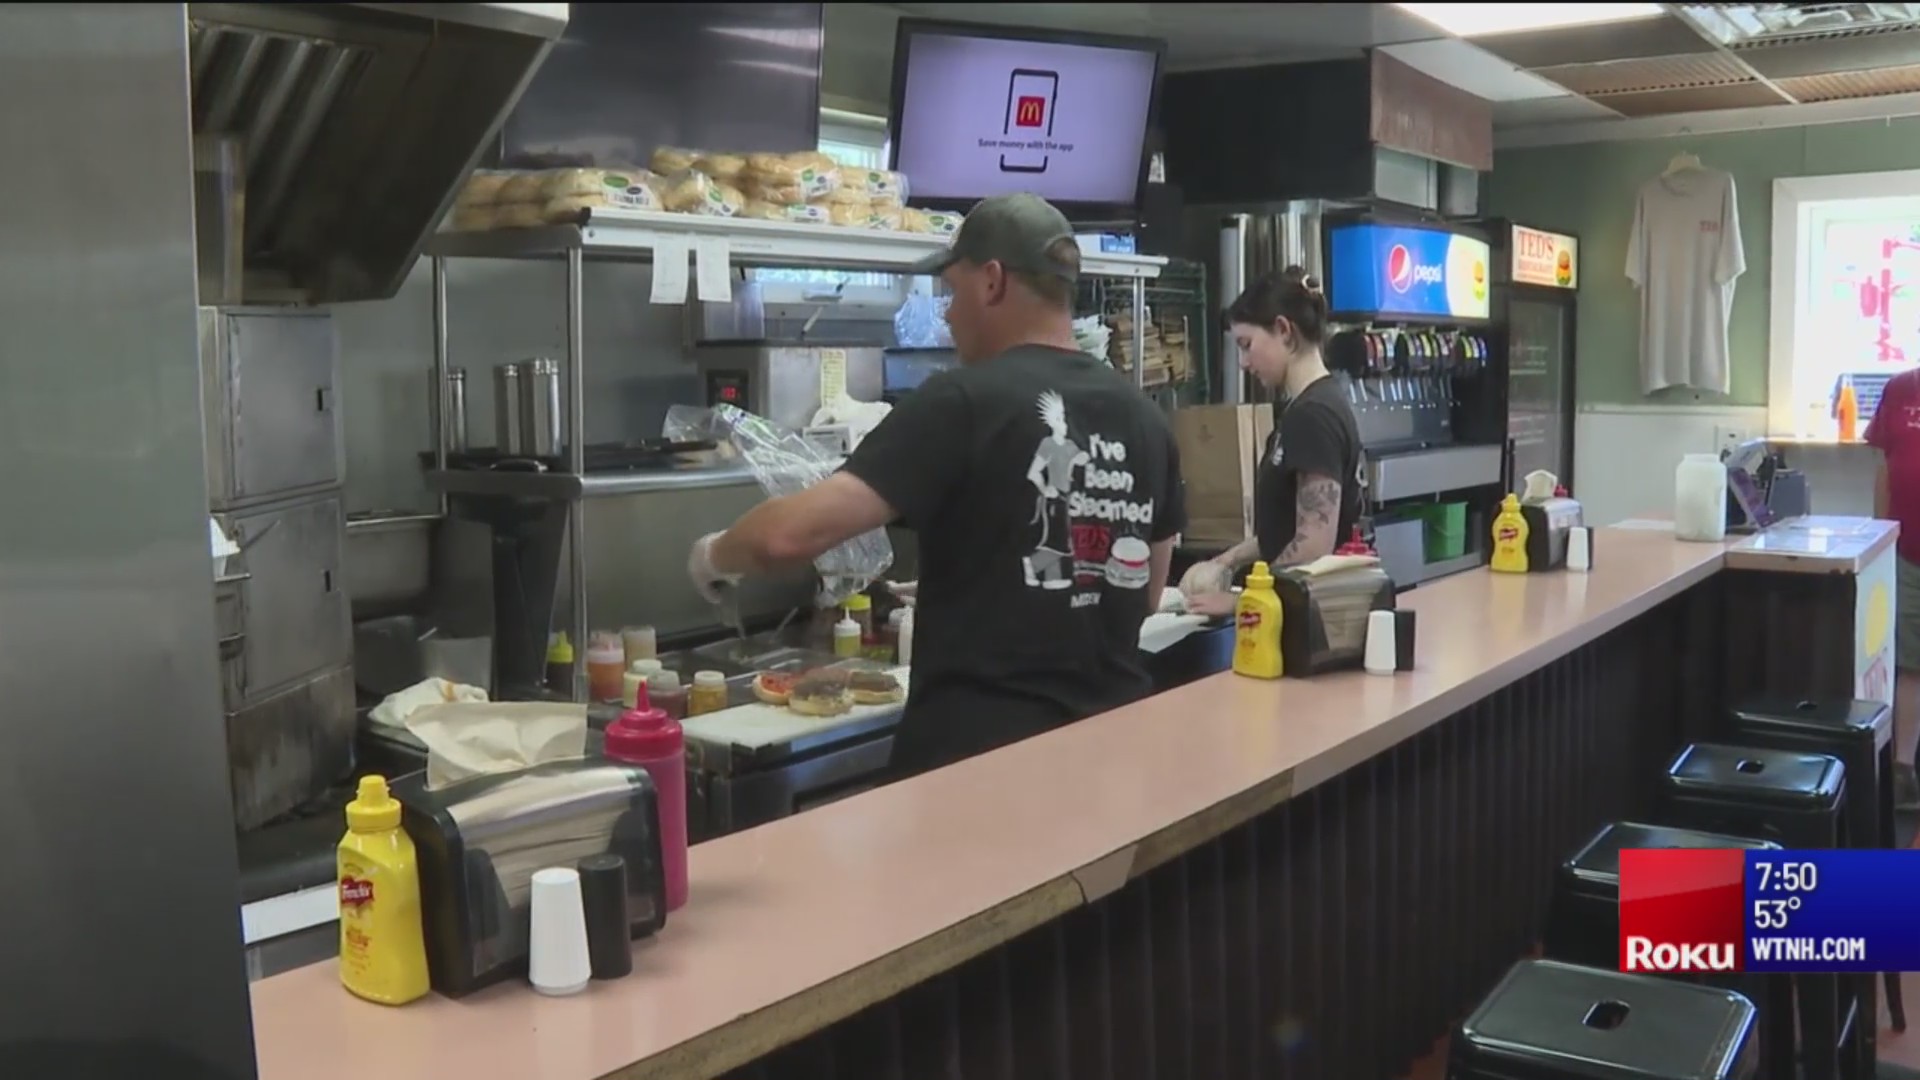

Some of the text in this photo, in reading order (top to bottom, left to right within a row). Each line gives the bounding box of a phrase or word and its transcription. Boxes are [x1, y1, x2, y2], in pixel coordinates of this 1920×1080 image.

[978, 138, 1074, 152] Save money with the app
[1414, 263, 1443, 285] pepsi
[1089, 432, 1126, 462] I've
[1084, 462, 1134, 494] Been
[1069, 490, 1153, 524] Steamed
